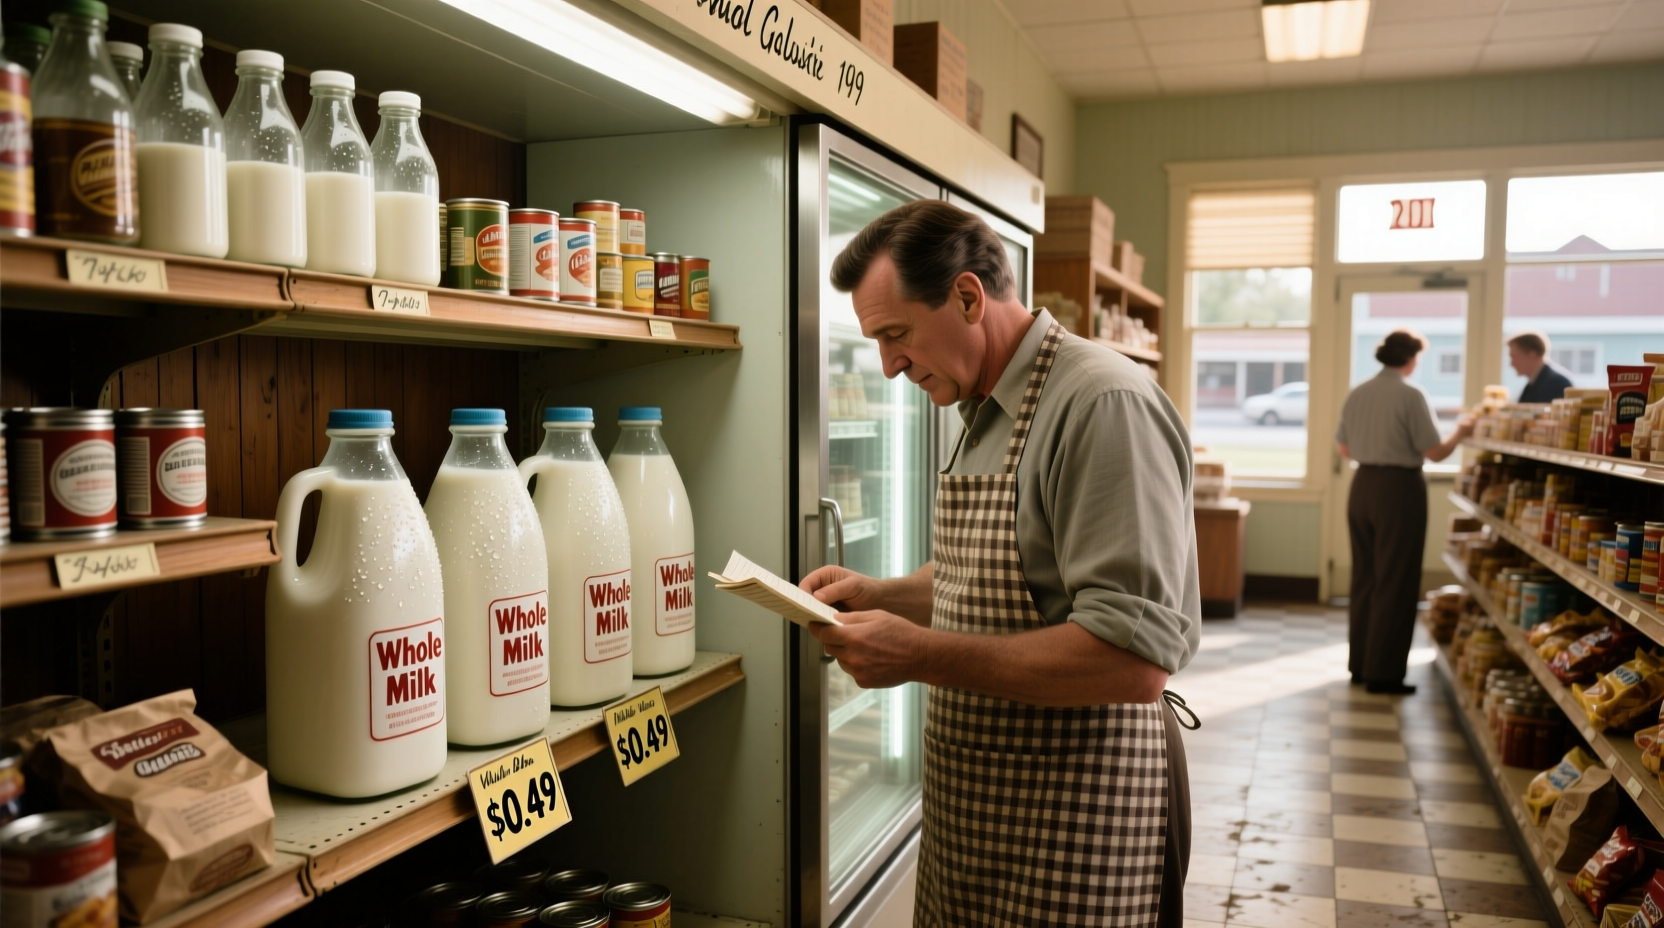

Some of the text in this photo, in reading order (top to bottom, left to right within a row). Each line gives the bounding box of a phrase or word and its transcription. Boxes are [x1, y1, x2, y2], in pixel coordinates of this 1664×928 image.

[837, 60, 865, 106] 199
[660, 560, 695, 587] Whole
[589, 578, 631, 608] Whole
[665, 586, 693, 612] Milk
[495, 601, 547, 635] Whole
[596, 606, 629, 636] Milk
[376, 631, 442, 671] Whole
[503, 631, 544, 666] Milk
[386, 666, 437, 706] Milk
[617, 714, 669, 770] $0.49
[486, 771, 556, 841] $0.49
